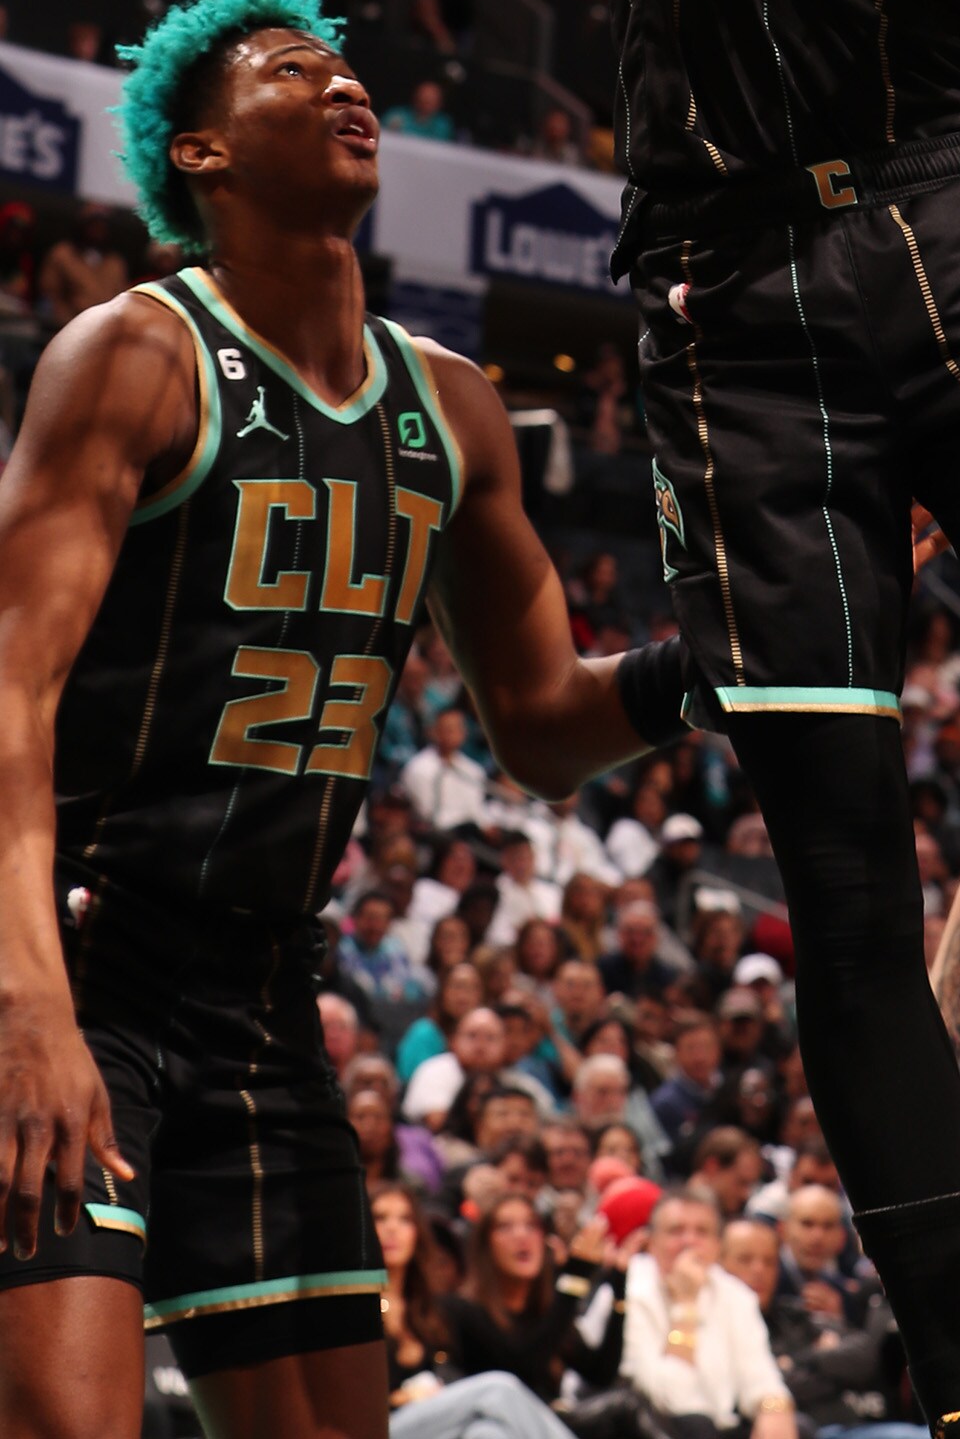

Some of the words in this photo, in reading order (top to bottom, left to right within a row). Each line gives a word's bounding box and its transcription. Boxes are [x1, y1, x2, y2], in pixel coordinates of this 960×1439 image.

[217, 347, 247, 380] 6
[223, 478, 444, 625] CLT
[207, 645, 394, 780] 23
